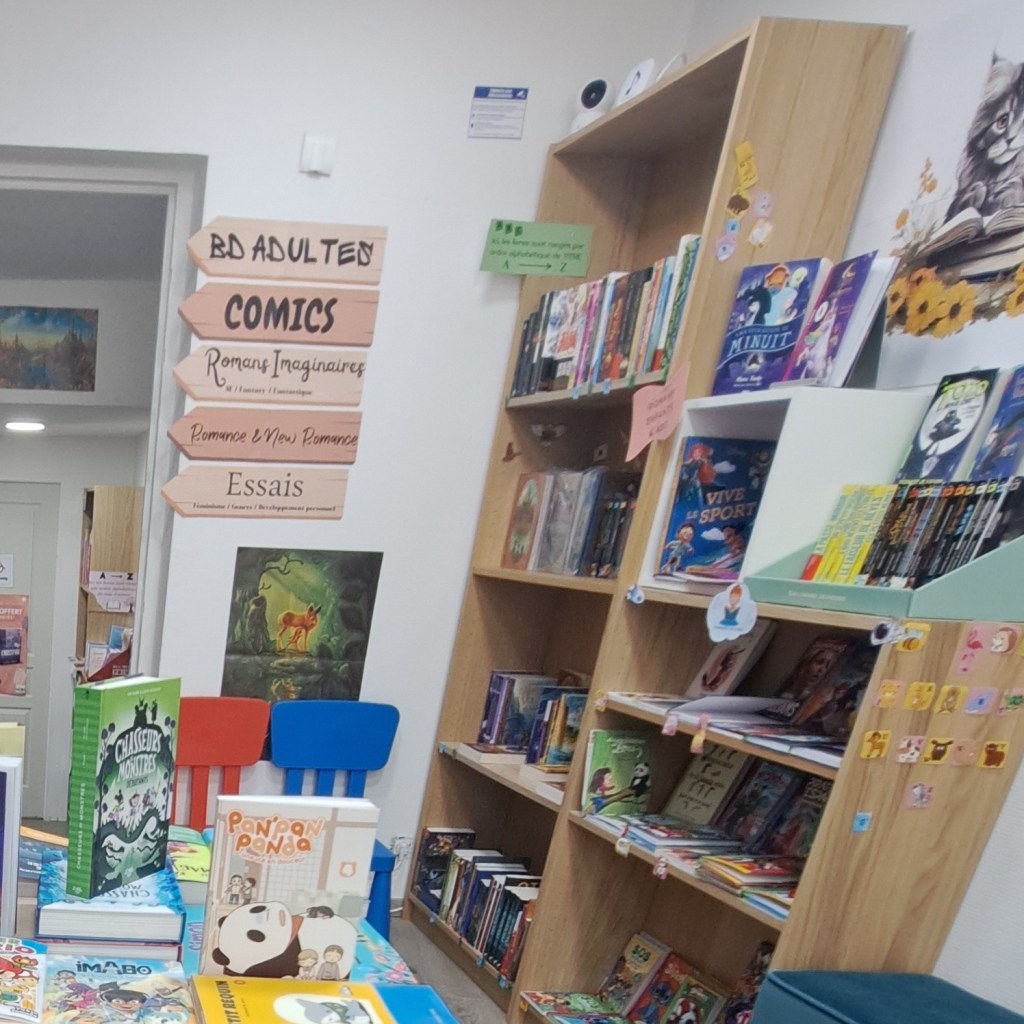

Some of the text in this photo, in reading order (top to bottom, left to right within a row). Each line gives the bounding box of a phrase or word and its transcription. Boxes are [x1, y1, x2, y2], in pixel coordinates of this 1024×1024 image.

[209, 232, 374, 267] BD ADULTES
[224, 293, 339, 334] COMICS
[727, 331, 792, 357] MINUIT
[204, 347, 366, 388] Romans Imaginaires
[190, 422, 246, 445] Romance
[263, 427, 297, 449] New
[302, 426, 359, 449] Romance
[226, 471, 305, 497] Essais
[705, 488, 745, 505] VIVE
[698, 503, 756, 525] SPORT
[127, 572, 133, 580] Z
[114, 726, 163, 764] CHASSEURS
[117, 753, 157, 782] MONSTRES
[216, 980, 238, 1011] REQUIN
